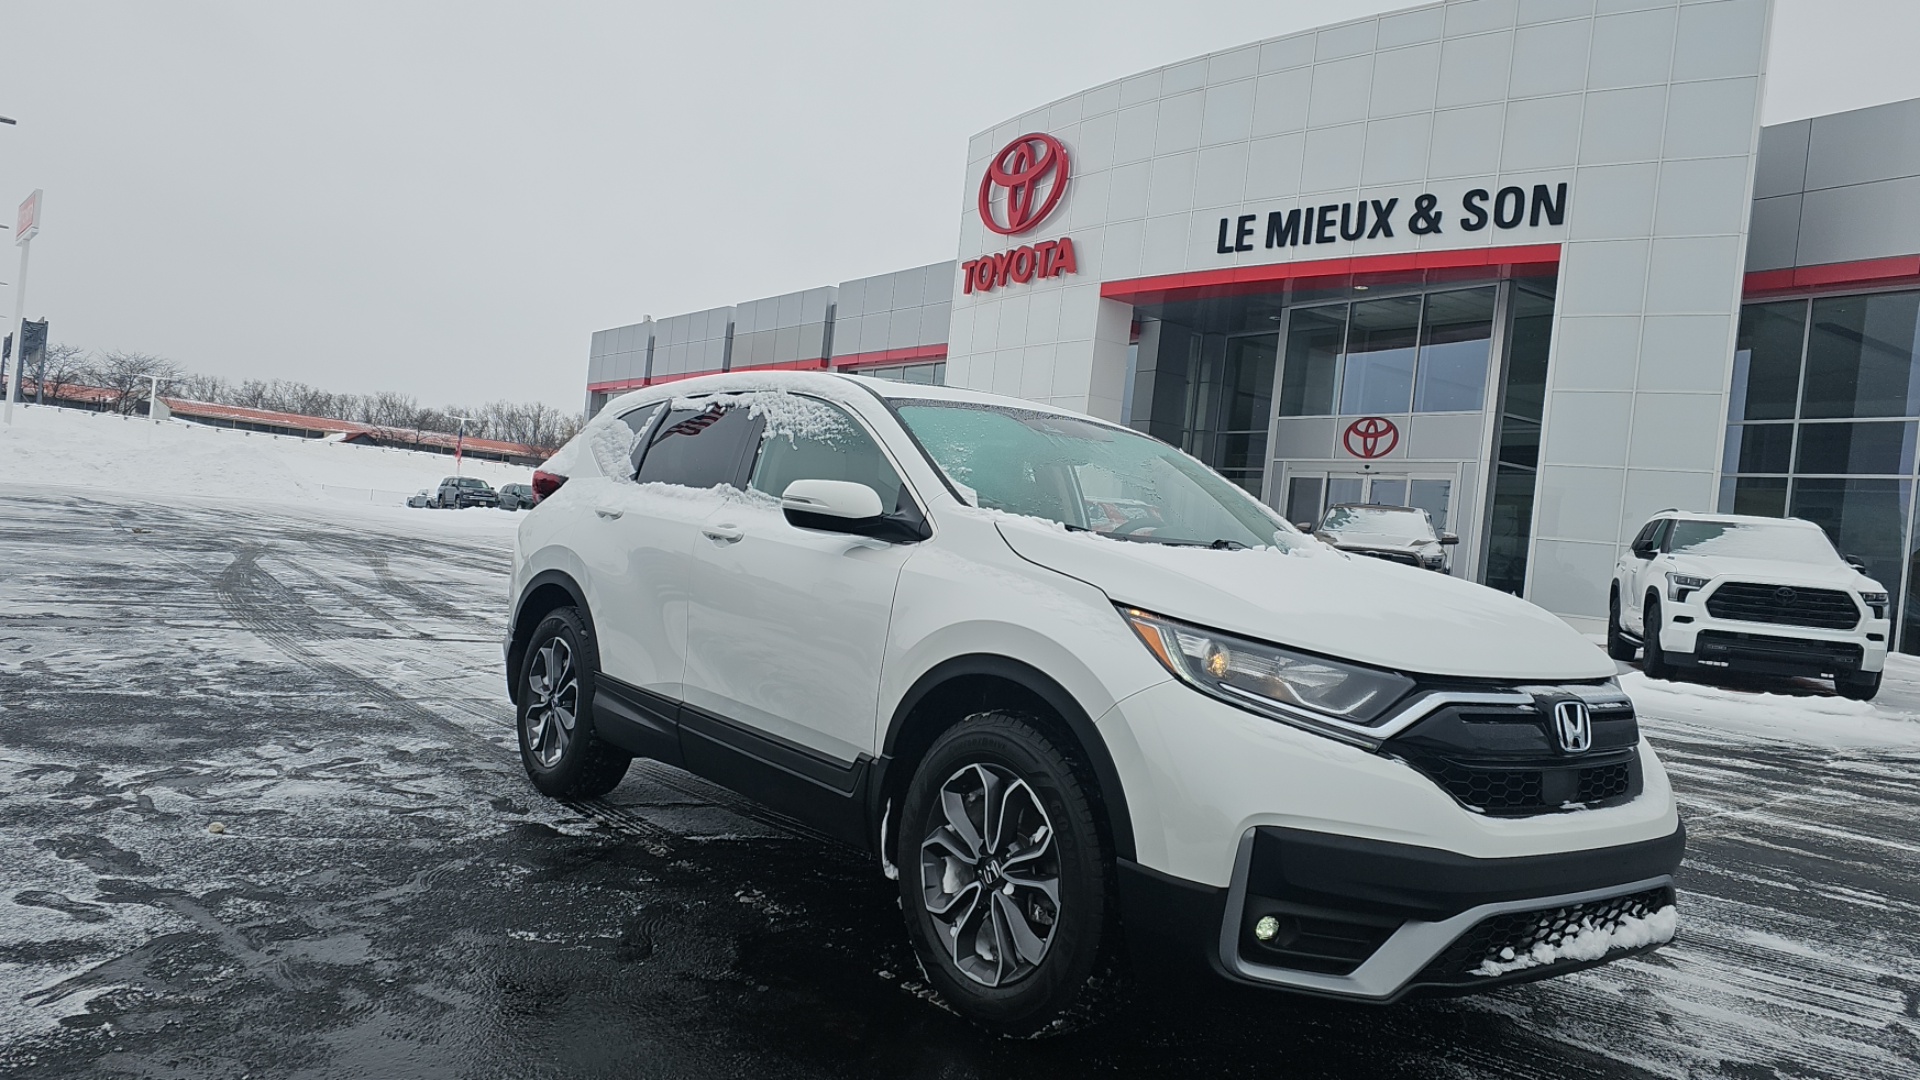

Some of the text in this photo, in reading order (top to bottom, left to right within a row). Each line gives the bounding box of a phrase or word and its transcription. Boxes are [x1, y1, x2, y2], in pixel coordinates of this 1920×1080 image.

[1216, 182, 1568, 254] LE MIEUX & SON
[962, 237, 1077, 294] TOYOTA
